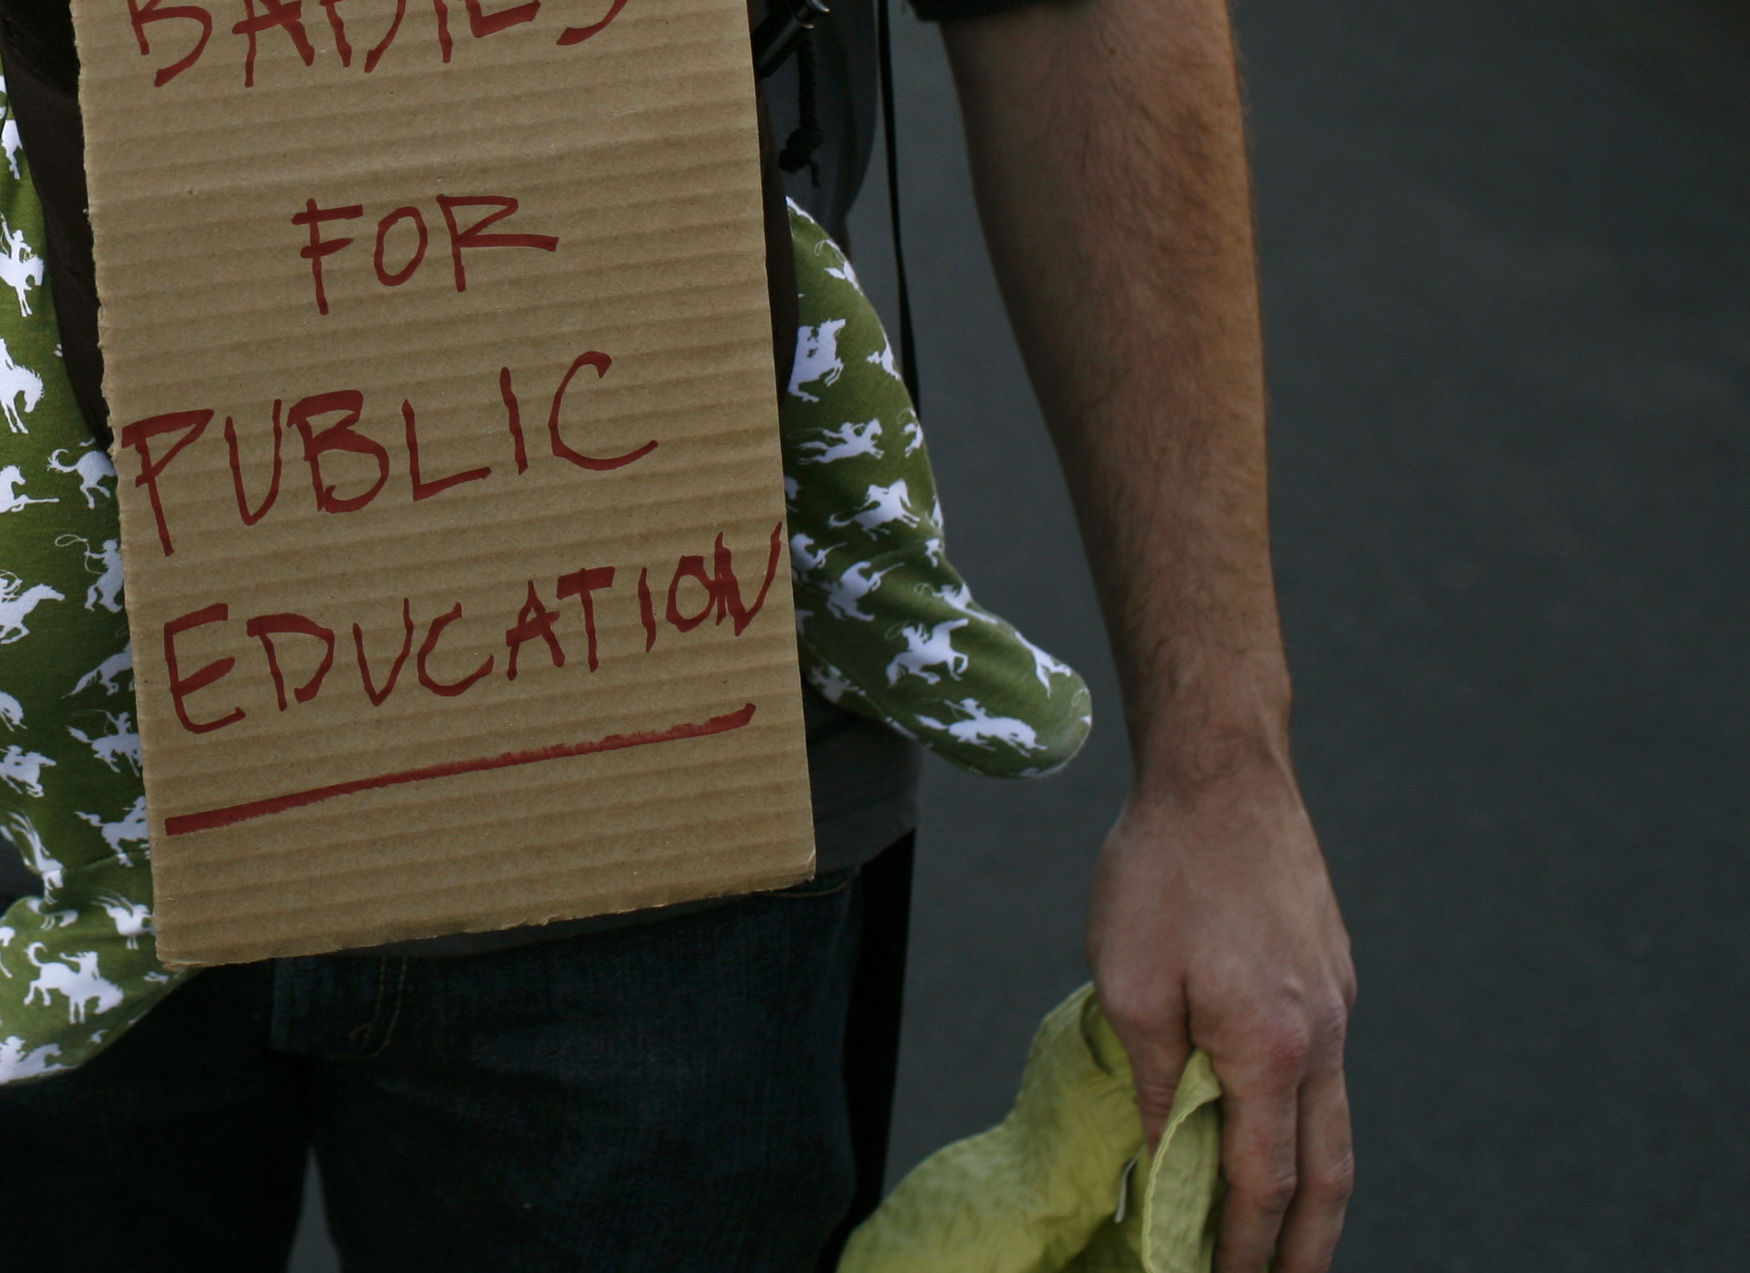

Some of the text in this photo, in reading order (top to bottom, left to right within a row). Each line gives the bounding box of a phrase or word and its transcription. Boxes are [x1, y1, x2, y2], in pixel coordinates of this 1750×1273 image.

[291, 194, 560, 315] FOR
[121, 349, 659, 556] PUBLIC
[163, 522, 784, 734] EDUCATION
